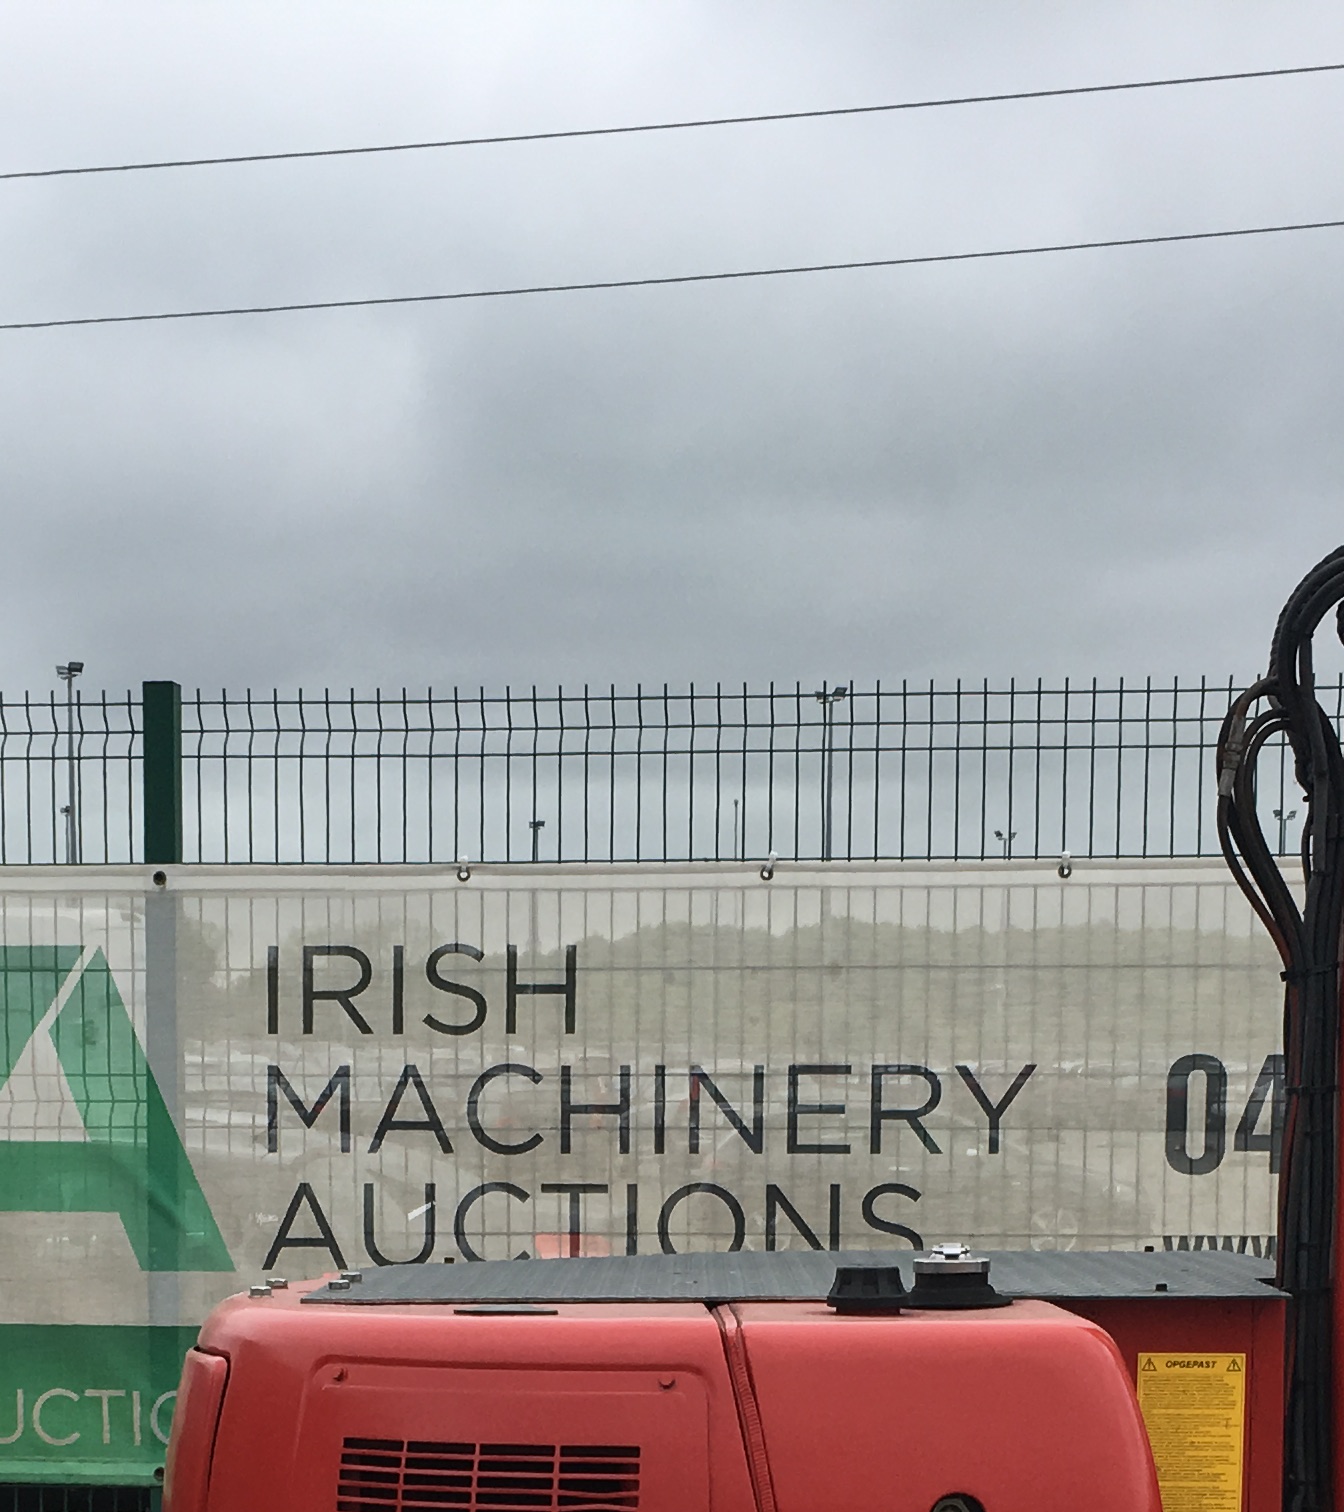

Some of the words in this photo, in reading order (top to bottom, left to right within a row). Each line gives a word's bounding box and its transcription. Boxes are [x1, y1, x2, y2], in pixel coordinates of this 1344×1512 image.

[267, 943, 577, 1036] IRISH
[266, 1063, 1038, 1156] MACHINERY
[262, 1182, 924, 1270] AUCTIONS
[1165, 1360, 1217, 1370] OPGEPAST
